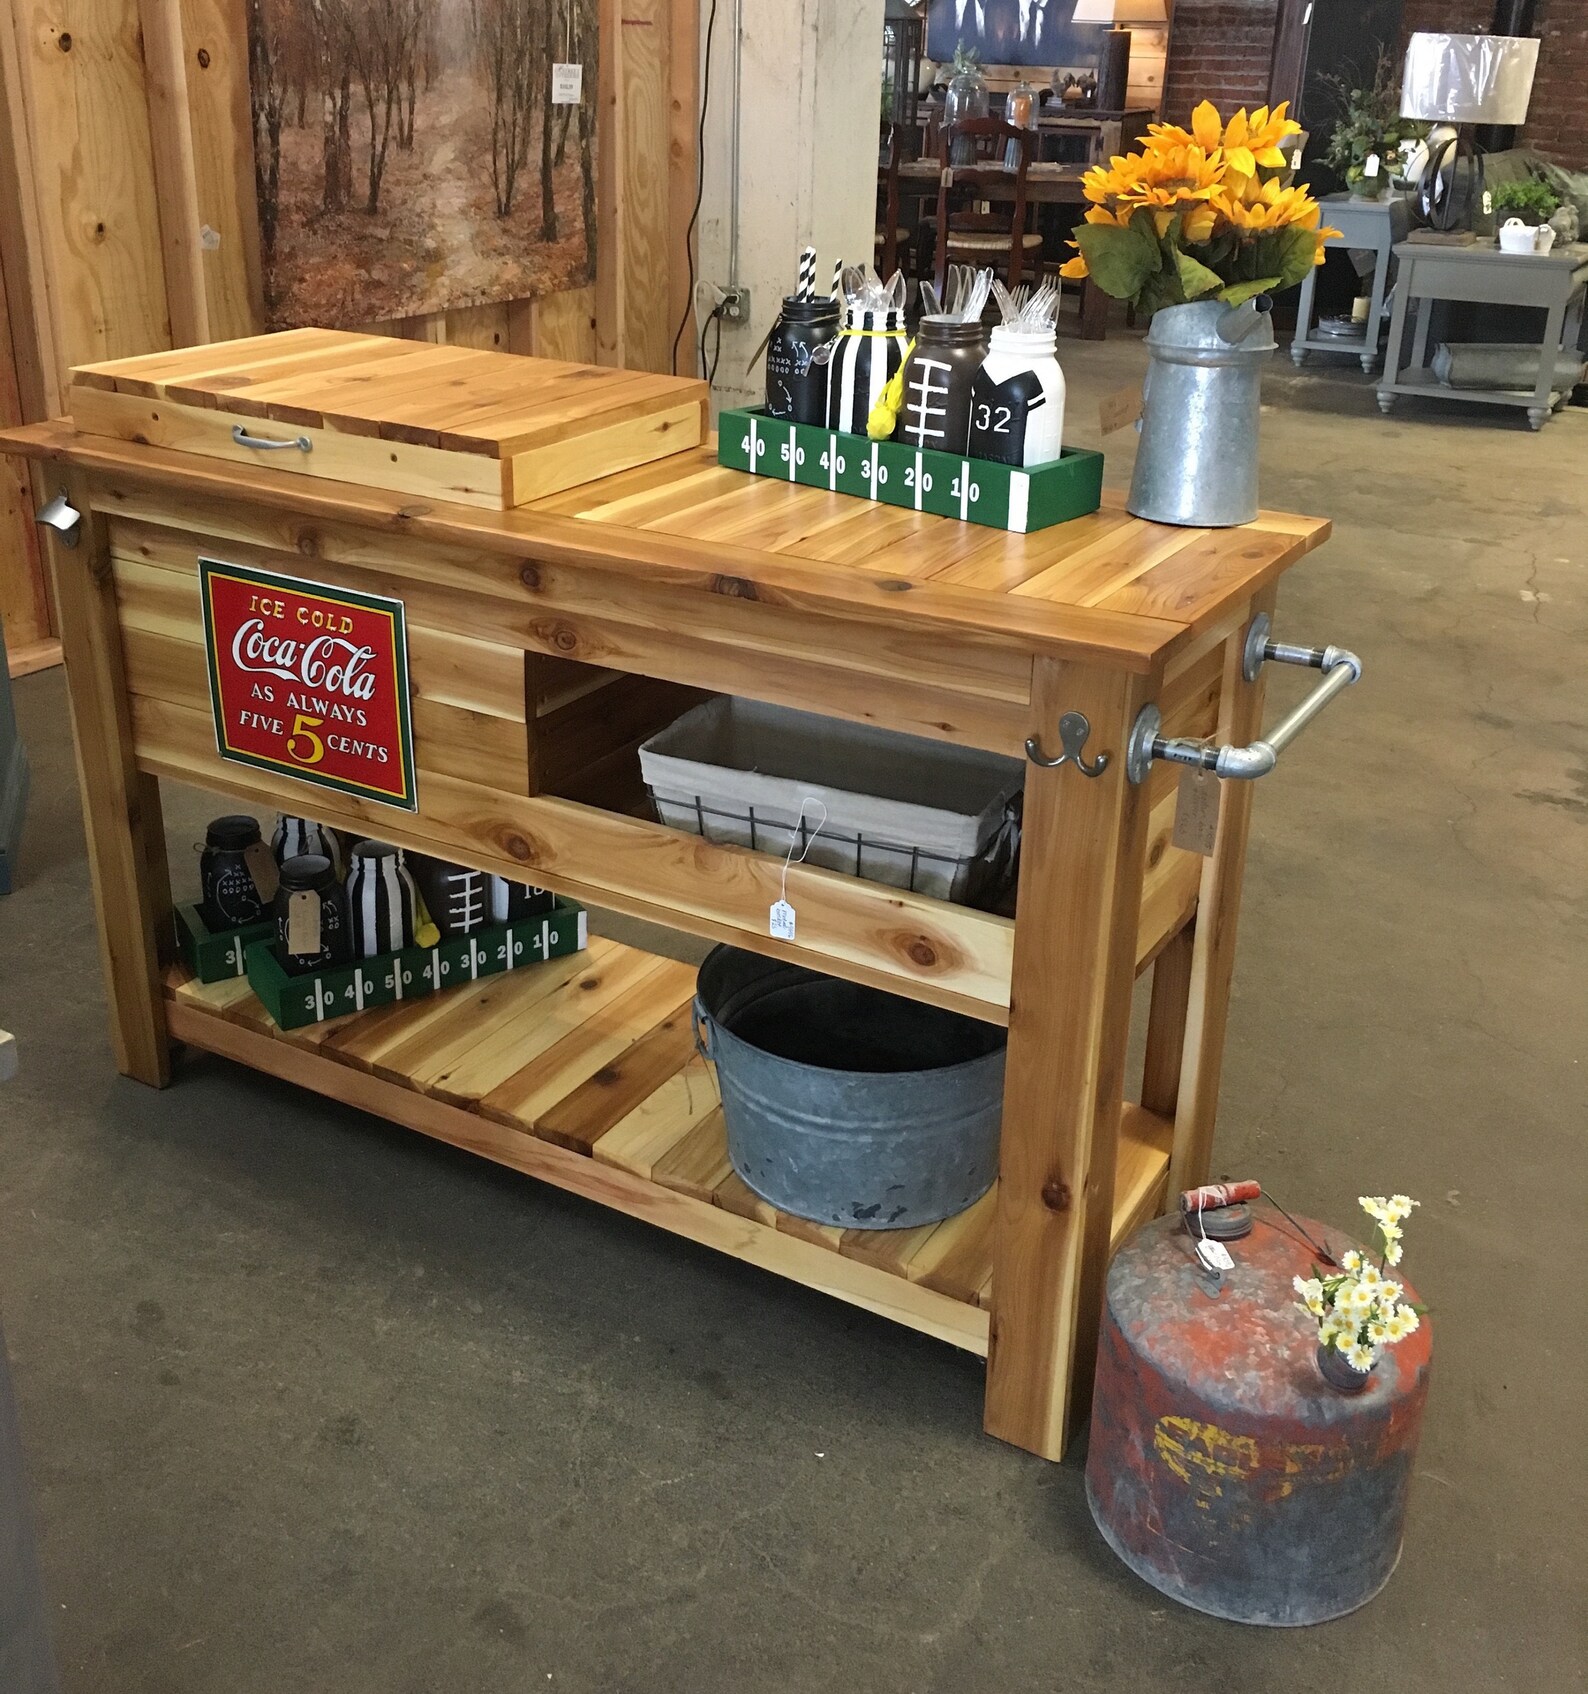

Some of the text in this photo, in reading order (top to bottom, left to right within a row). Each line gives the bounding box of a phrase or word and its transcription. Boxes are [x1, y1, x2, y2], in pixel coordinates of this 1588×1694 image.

[974, 404, 1012, 433] 32
[249, 595, 354, 634] ICE COLD
[231, 618, 377, 701] Coca-Cola
[250, 683, 367, 727] AS ALWAYS
[239, 709, 389, 764] FIVE 5 CENTS
